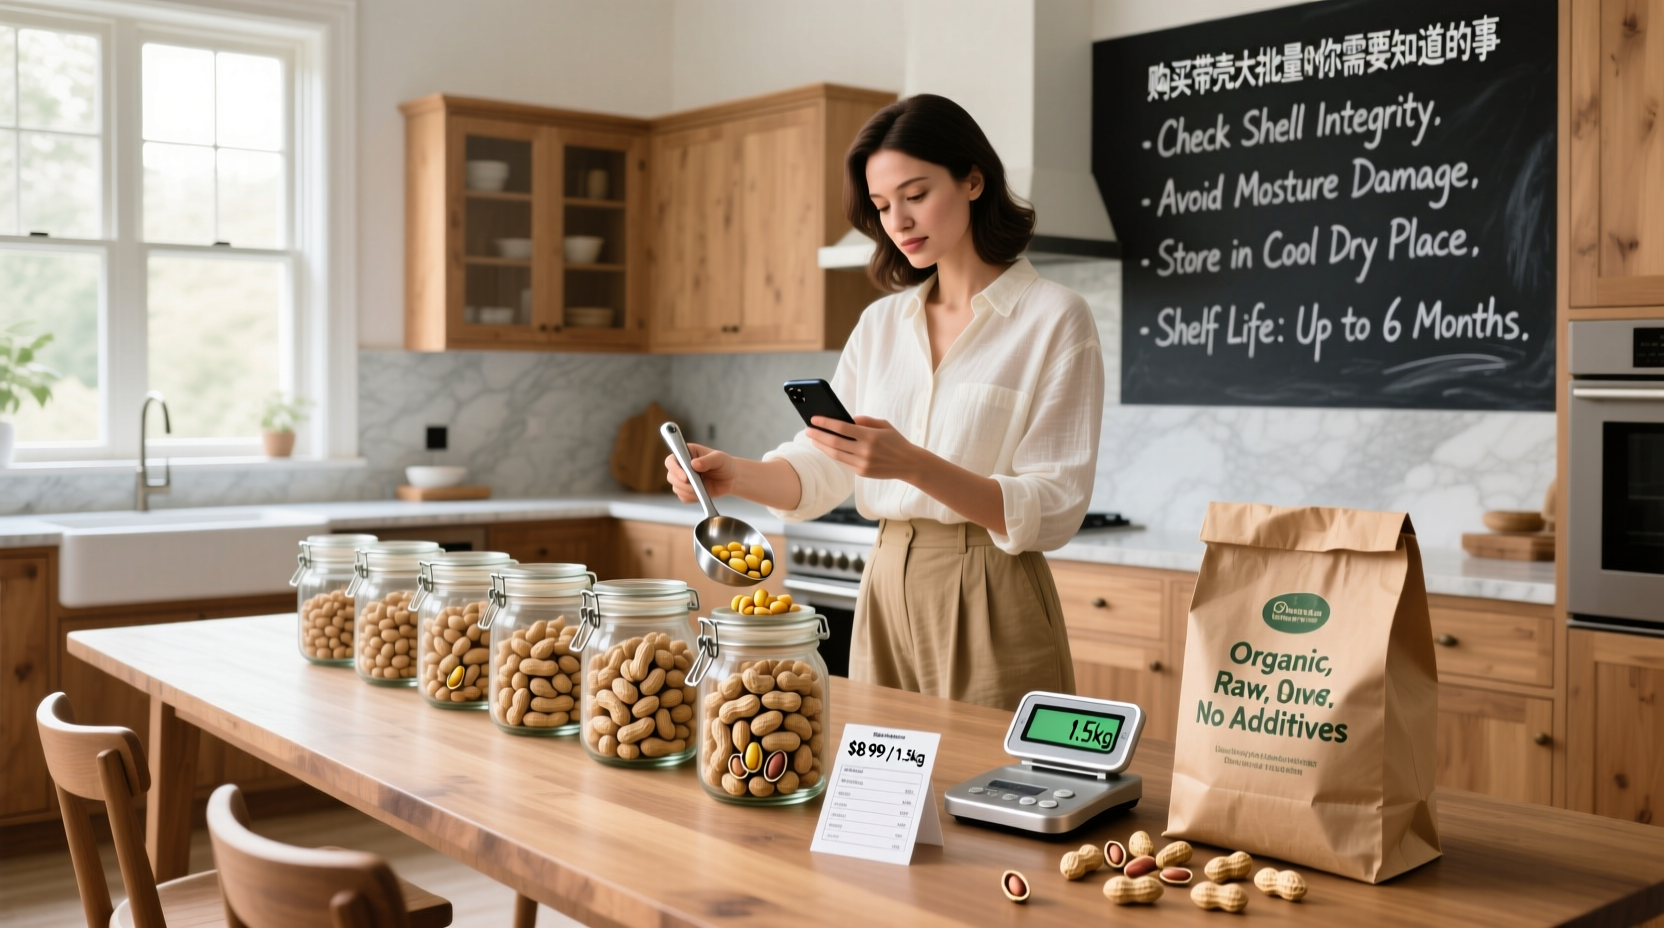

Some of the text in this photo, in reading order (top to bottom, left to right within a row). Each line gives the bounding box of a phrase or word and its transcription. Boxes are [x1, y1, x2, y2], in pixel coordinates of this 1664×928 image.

[1157, 92, 1441, 157] Check Shell Integrity.
[1157, 173, 1225, 216] Avoid
[1233, 170, 1339, 208] Mosture
[1156, 239, 1221, 277] Store
[1230, 239, 1253, 270] in
[1263, 225, 1319, 269] Cool
[1328, 224, 1378, 284] Dry
[1154, 296, 1530, 363] Shelf Life: Up to 6 Months.
[1229, 641, 1333, 677] Organic,
[1213, 670, 1270, 704] Raw,
[1069, 719, 1114, 749] 1.5kg
[1196, 699, 1349, 744] No Additives
